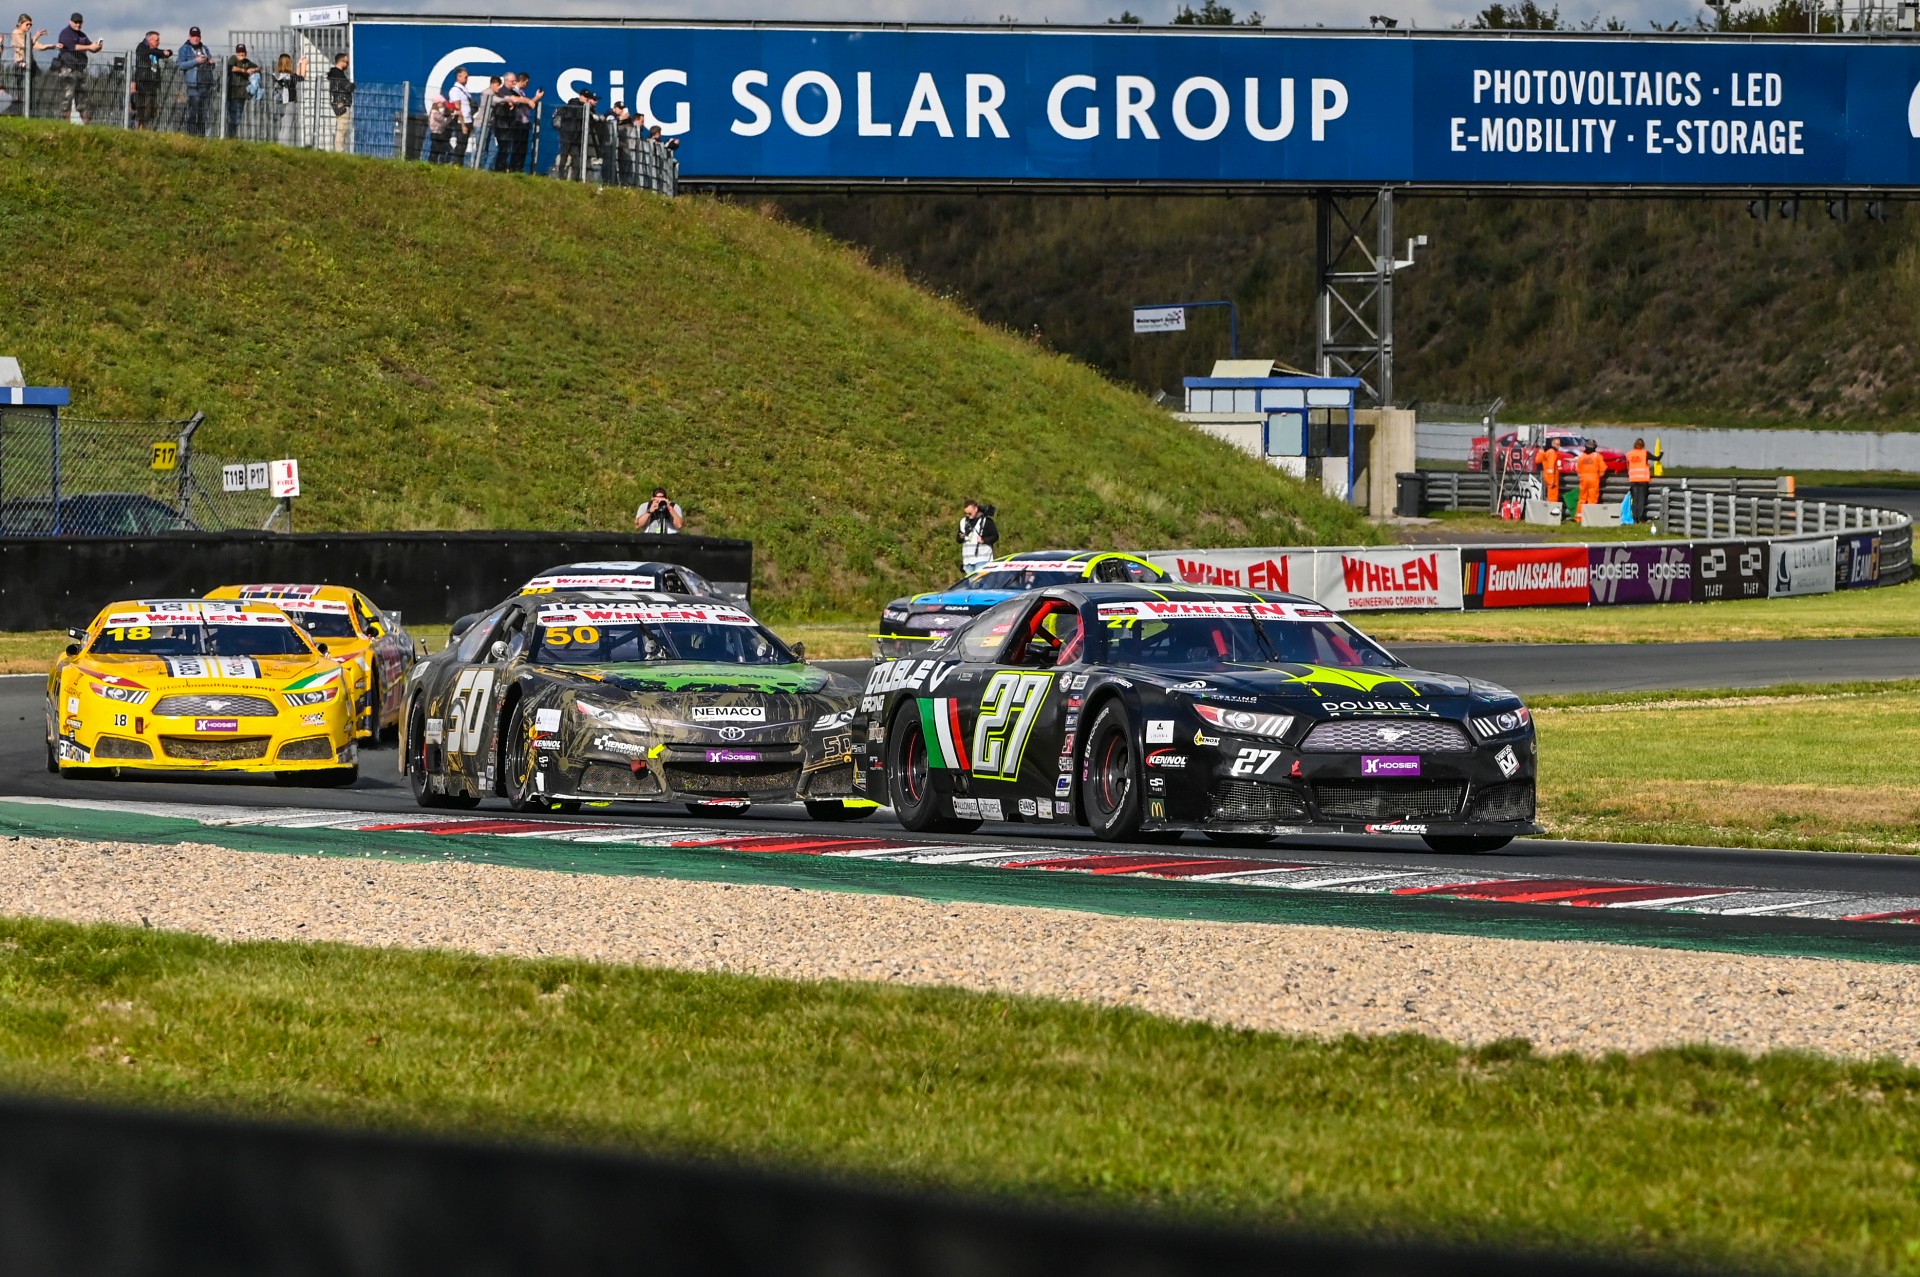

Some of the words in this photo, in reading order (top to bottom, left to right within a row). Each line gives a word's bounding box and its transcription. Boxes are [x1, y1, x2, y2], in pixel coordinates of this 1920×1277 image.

[1472, 69, 1702, 107] PHOTOVOLTAICS
[1731, 72, 1783, 107] LED
[731, 70, 1011, 138] SOLAR
[1047, 74, 1349, 142] GROUP
[1450, 117, 1617, 154] E-MOBILITY
[1646, 120, 1805, 155] E-STORAGE
[152, 448, 175, 464] F17
[224, 471, 244, 486] T11B
[251, 469, 265, 484] P17
[1341, 553, 1438, 593] WHELEN
[1488, 561, 1588, 591] EuroNASCAR.com
[1590, 562, 1640, 579] HOOSIER
[1648, 562, 1691, 579] HOOSIER
[540, 601, 738, 612] Travala.com
[1144, 598, 1287, 615] WHELEN
[1348, 595, 1394, 608] ENGINEERING
[1396, 595, 1425, 606] COMPANY
[1427, 595, 1439, 606] INC.
[145, 613, 249, 622] WHELEN
[582, 609, 709, 620] WHELEN
[1107, 615, 1138, 629] 27
[106, 626, 152, 642] 18
[545, 625, 600, 646] 50
[865, 659, 937, 695] DOUBLE
[929, 661, 958, 693] V
[448, 667, 496, 756] 50
[694, 707, 763, 717] NEMACO
[1321, 701, 1414, 712] DOUBLE
[1416, 702, 1430, 712] V
[114, 713, 128, 727] 18
[206, 721, 238, 729] HOOSIER
[971, 670, 1056, 783] 27
[533, 739, 562, 749] KENNOL
[604, 739, 646, 753] HENDRIKS
[605, 746, 642, 756] MOTORSPORT
[822, 732, 852, 759] 50
[720, 753, 757, 761] HOOSIER
[1148, 755, 1187, 765] KENNOL
[1231, 747, 1282, 775] 27
[1019, 800, 1036, 811] EVANS
[1370, 824, 1428, 832] KENNOL
